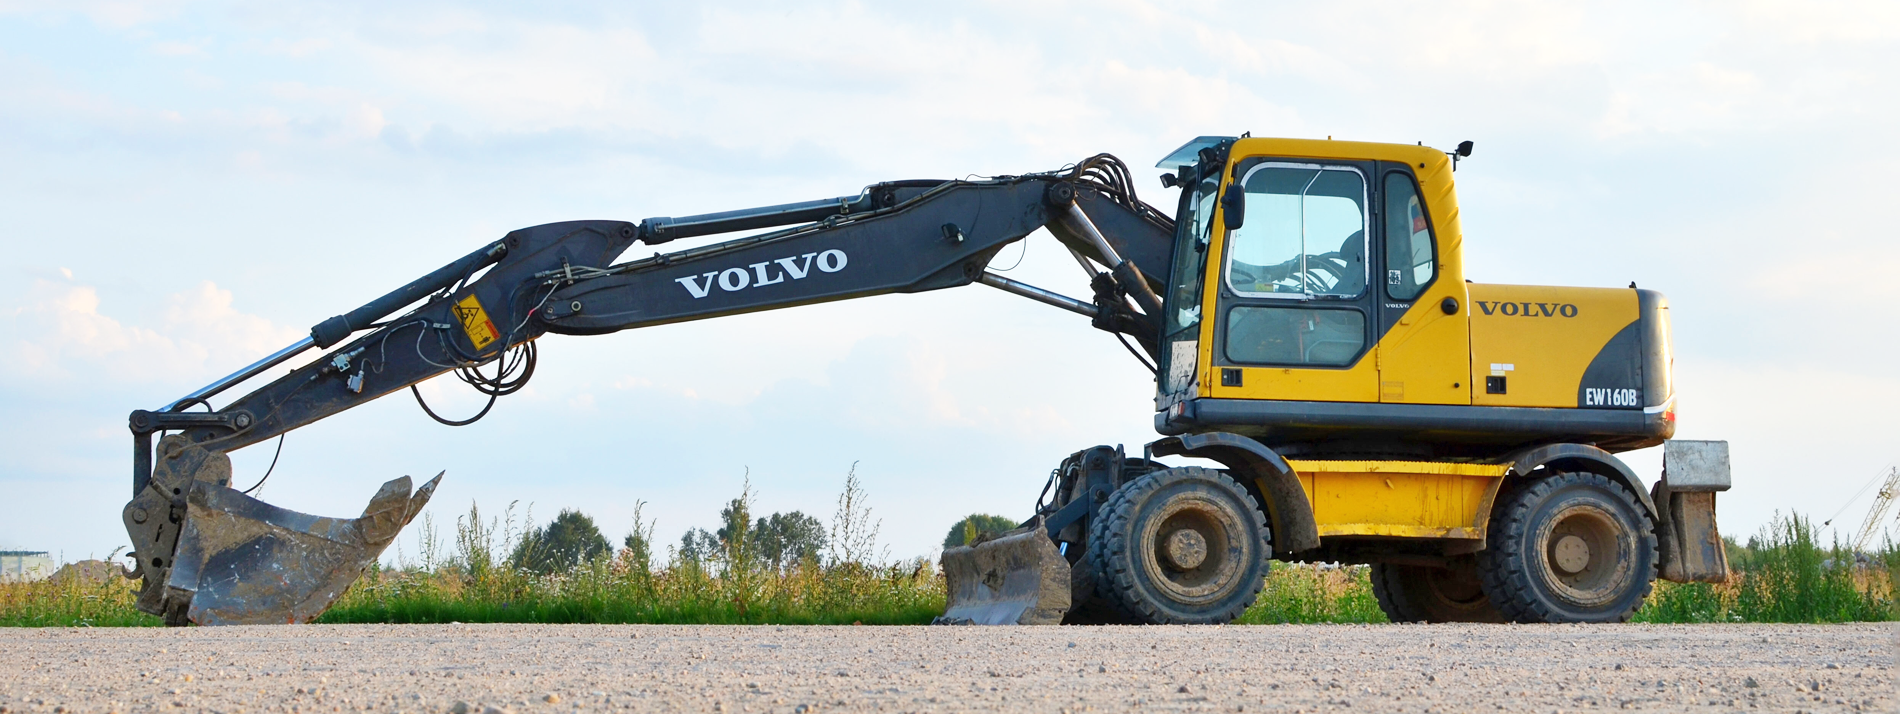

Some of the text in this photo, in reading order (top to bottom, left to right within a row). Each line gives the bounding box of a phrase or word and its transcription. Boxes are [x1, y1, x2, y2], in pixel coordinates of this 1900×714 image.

[674, 249, 848, 299] VOLVO
[1475, 300, 1578, 318] VOLVO
[1585, 388, 1637, 406] EW160B
